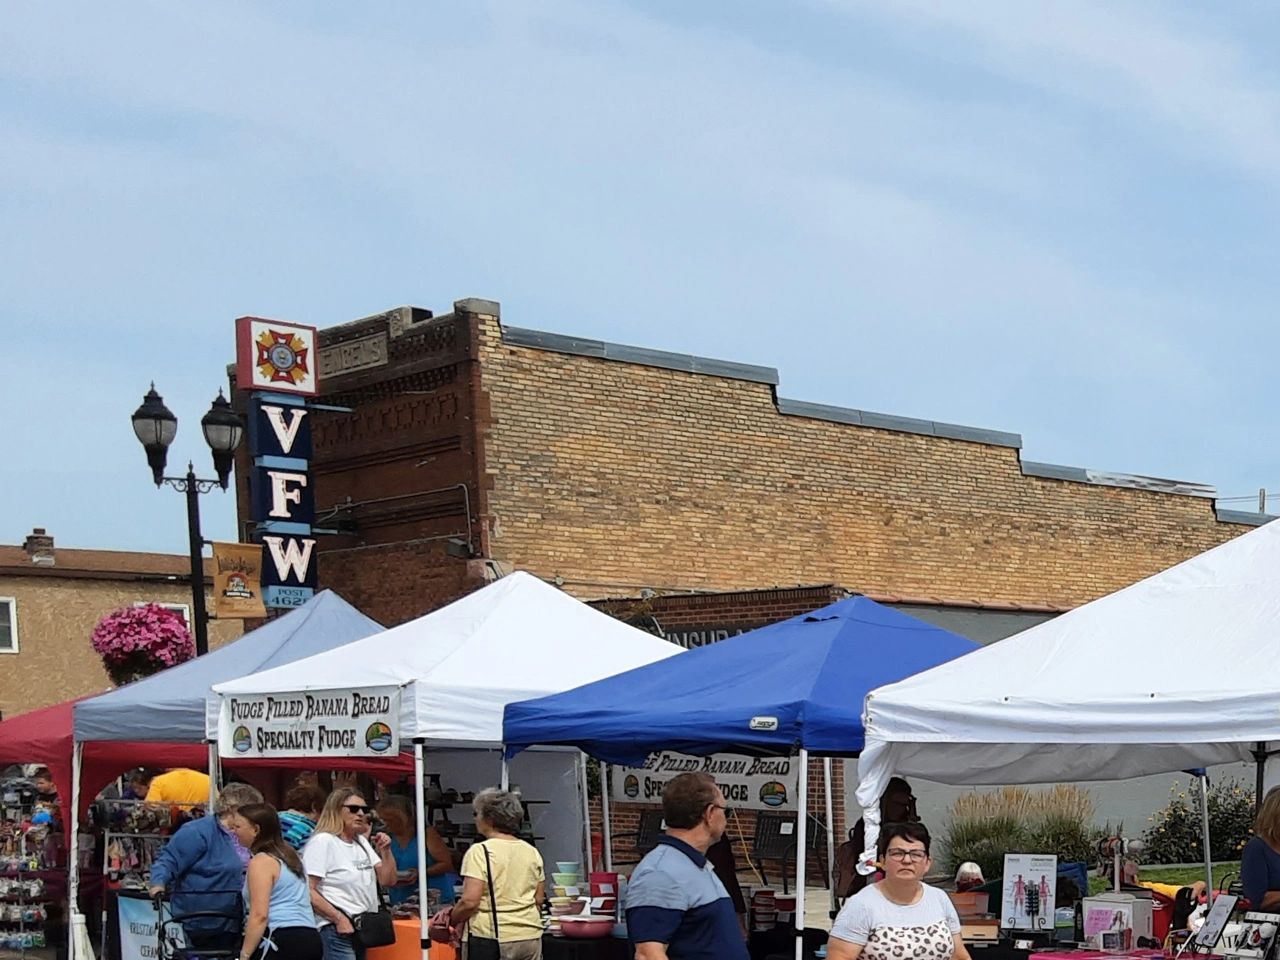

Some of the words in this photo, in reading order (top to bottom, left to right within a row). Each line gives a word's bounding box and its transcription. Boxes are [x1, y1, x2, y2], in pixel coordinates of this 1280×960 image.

[278, 589, 305, 597] POST
[230, 698, 264, 722] FUDGE
[265, 696, 304, 722] FILLED
[305, 694, 349, 720] BANANA
[351, 692, 390, 719] BREAD
[256, 727, 315, 751] SPECIALTY
[318, 725, 356, 751] FUDGE
[655, 754, 700, 773] FILLED
[744, 757, 790, 776] BREAD
[715, 782, 749, 802] DGE
